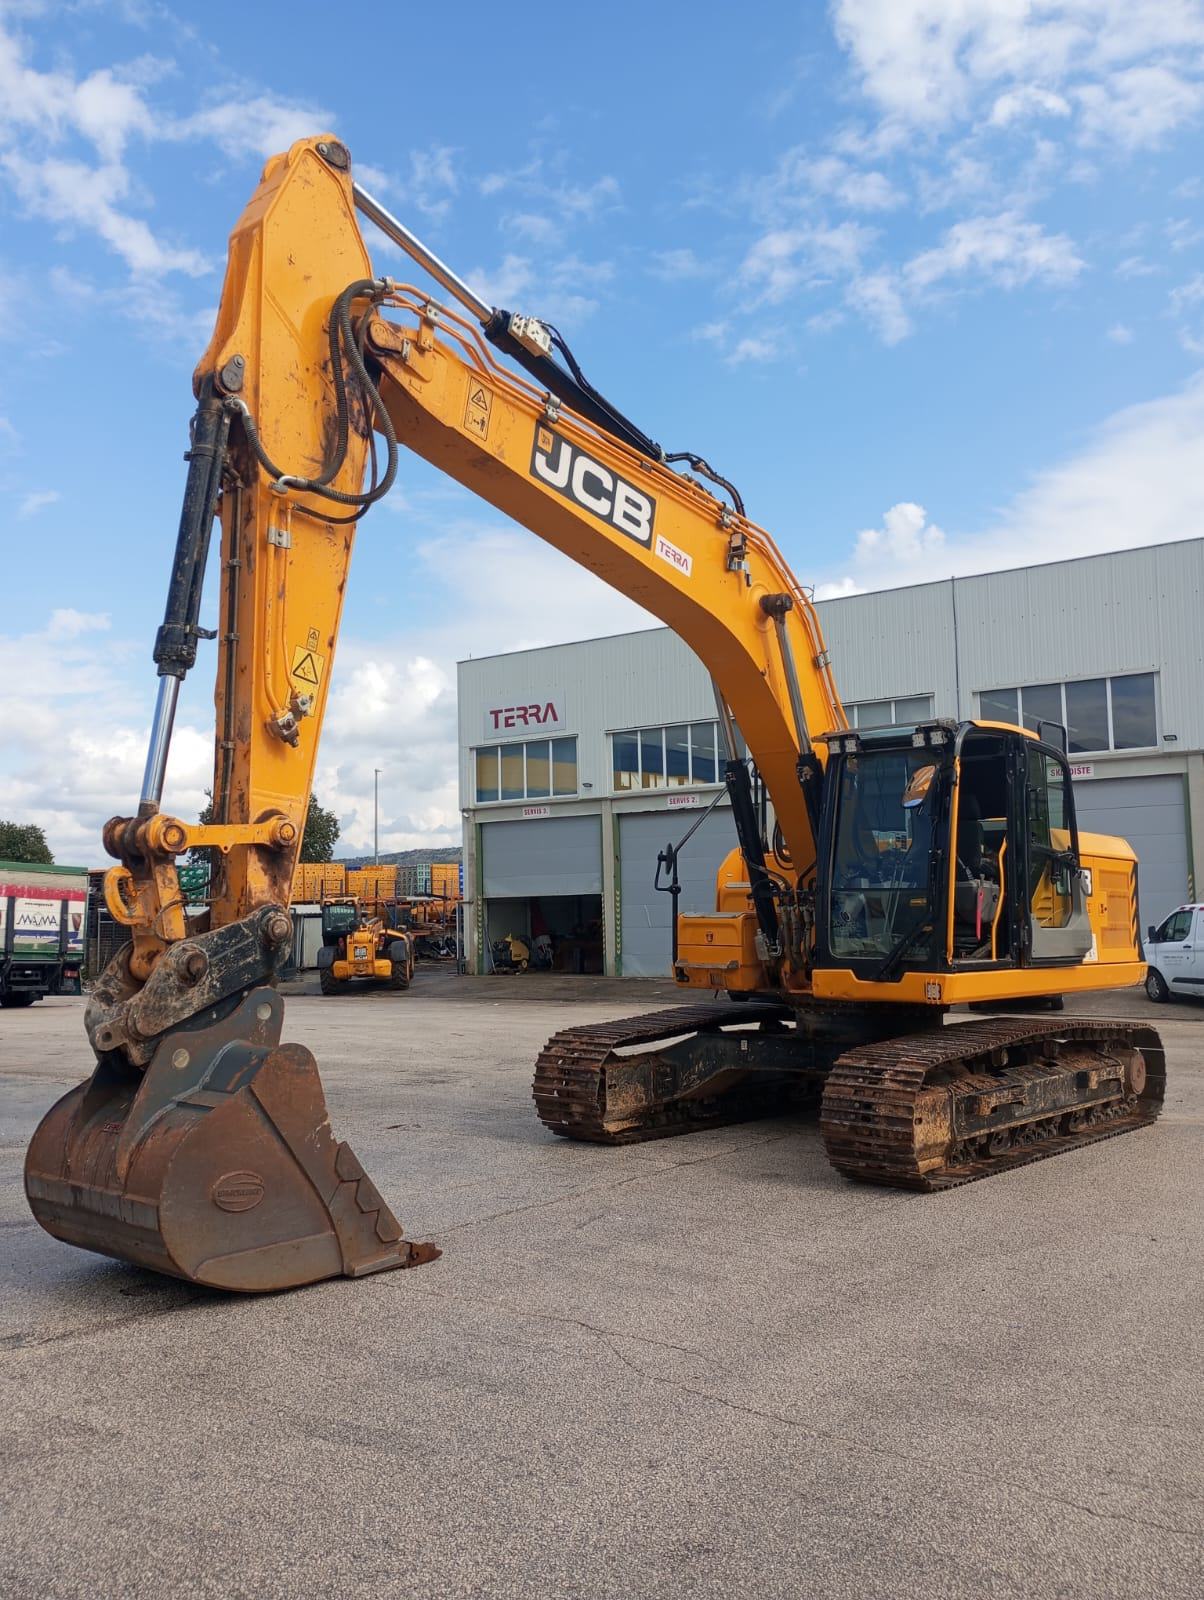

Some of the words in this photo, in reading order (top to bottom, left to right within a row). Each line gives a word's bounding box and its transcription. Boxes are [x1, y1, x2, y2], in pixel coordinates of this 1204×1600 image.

[535, 441, 651, 541] JCB
[659, 540, 689, 571] TERRA
[489, 702, 558, 729] TERRA
